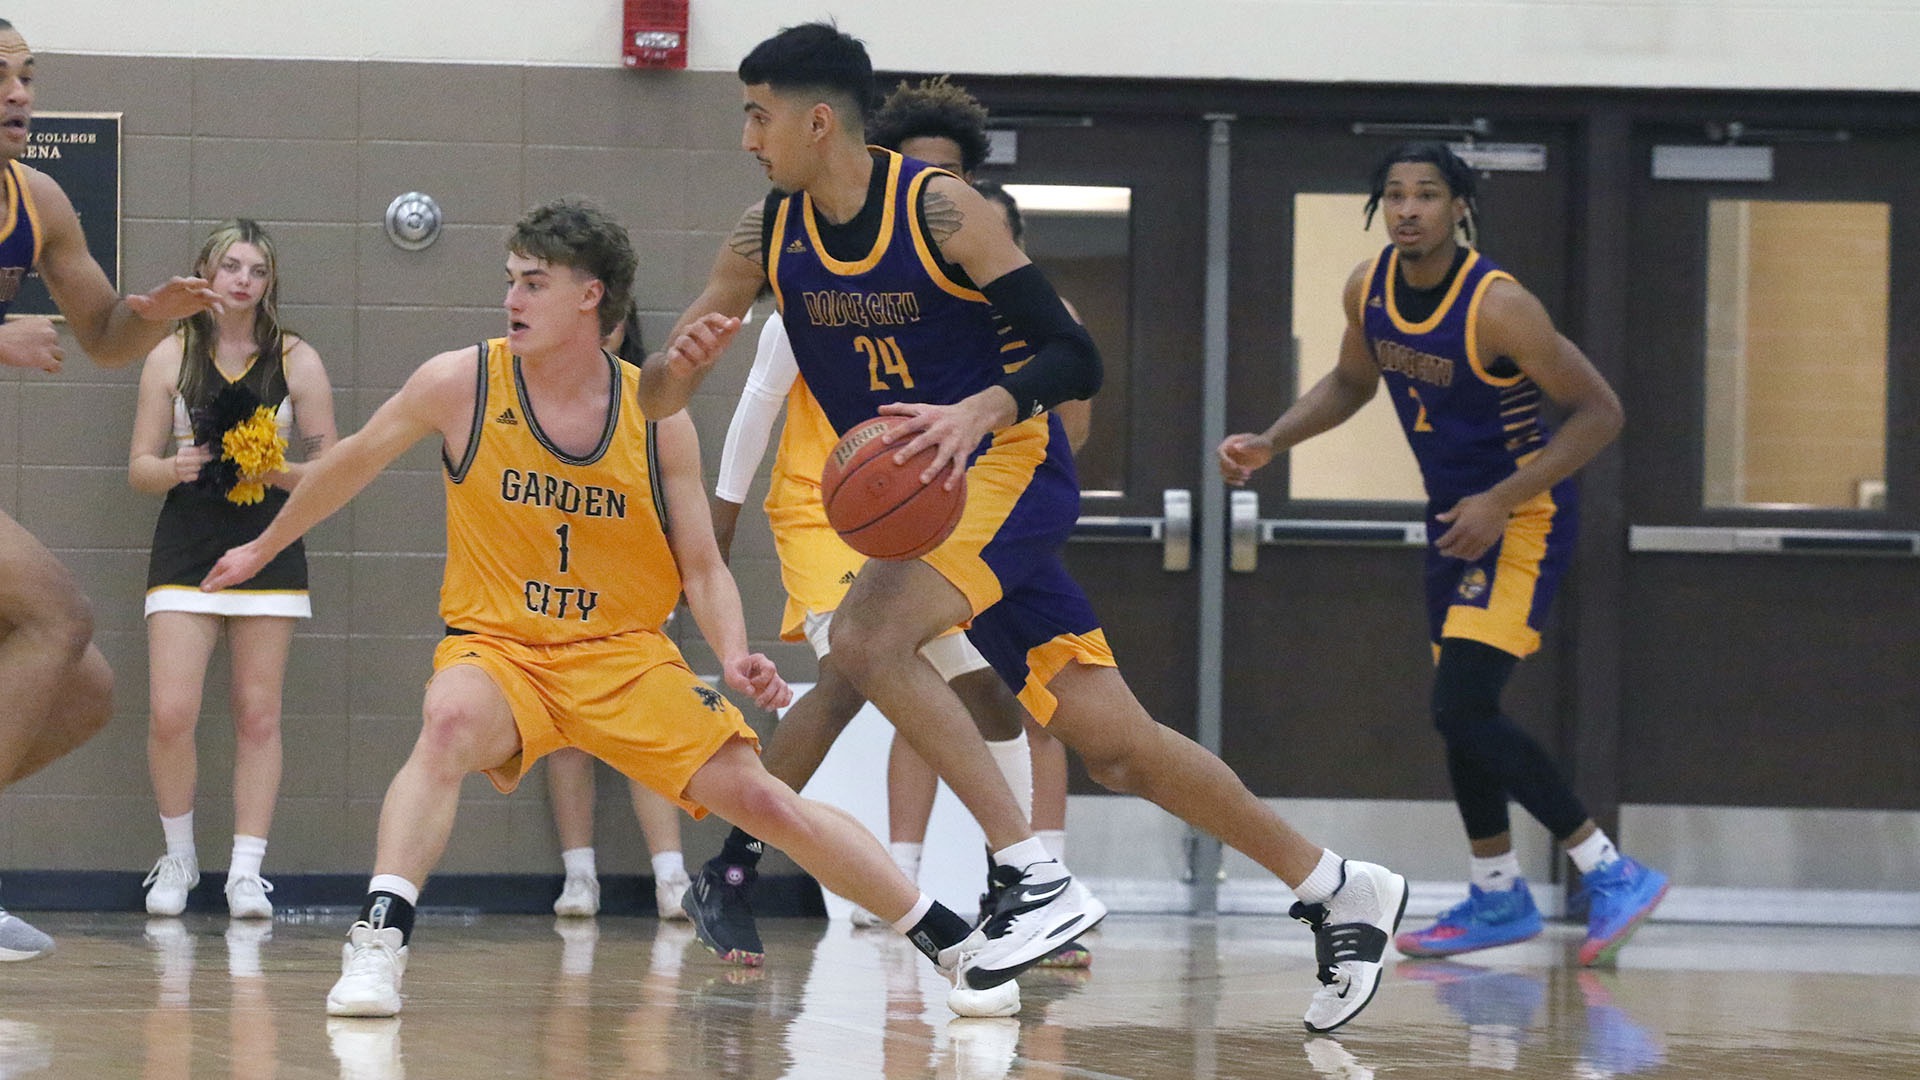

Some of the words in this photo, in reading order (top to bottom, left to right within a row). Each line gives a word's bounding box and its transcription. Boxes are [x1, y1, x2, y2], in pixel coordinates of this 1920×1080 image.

[21, 145, 62, 159] ENA
[36, 132, 97, 144] COLLEGE
[802, 290, 868, 327] DODGE
[867, 292, 921, 325] CITY
[853, 335, 914, 392] 24
[496, 417, 518, 425] adidas
[1408, 385, 1434, 432] 2
[502, 468, 626, 519] GARDEN
[555, 523, 571, 573] 1
[524, 580, 599, 622] CITY
